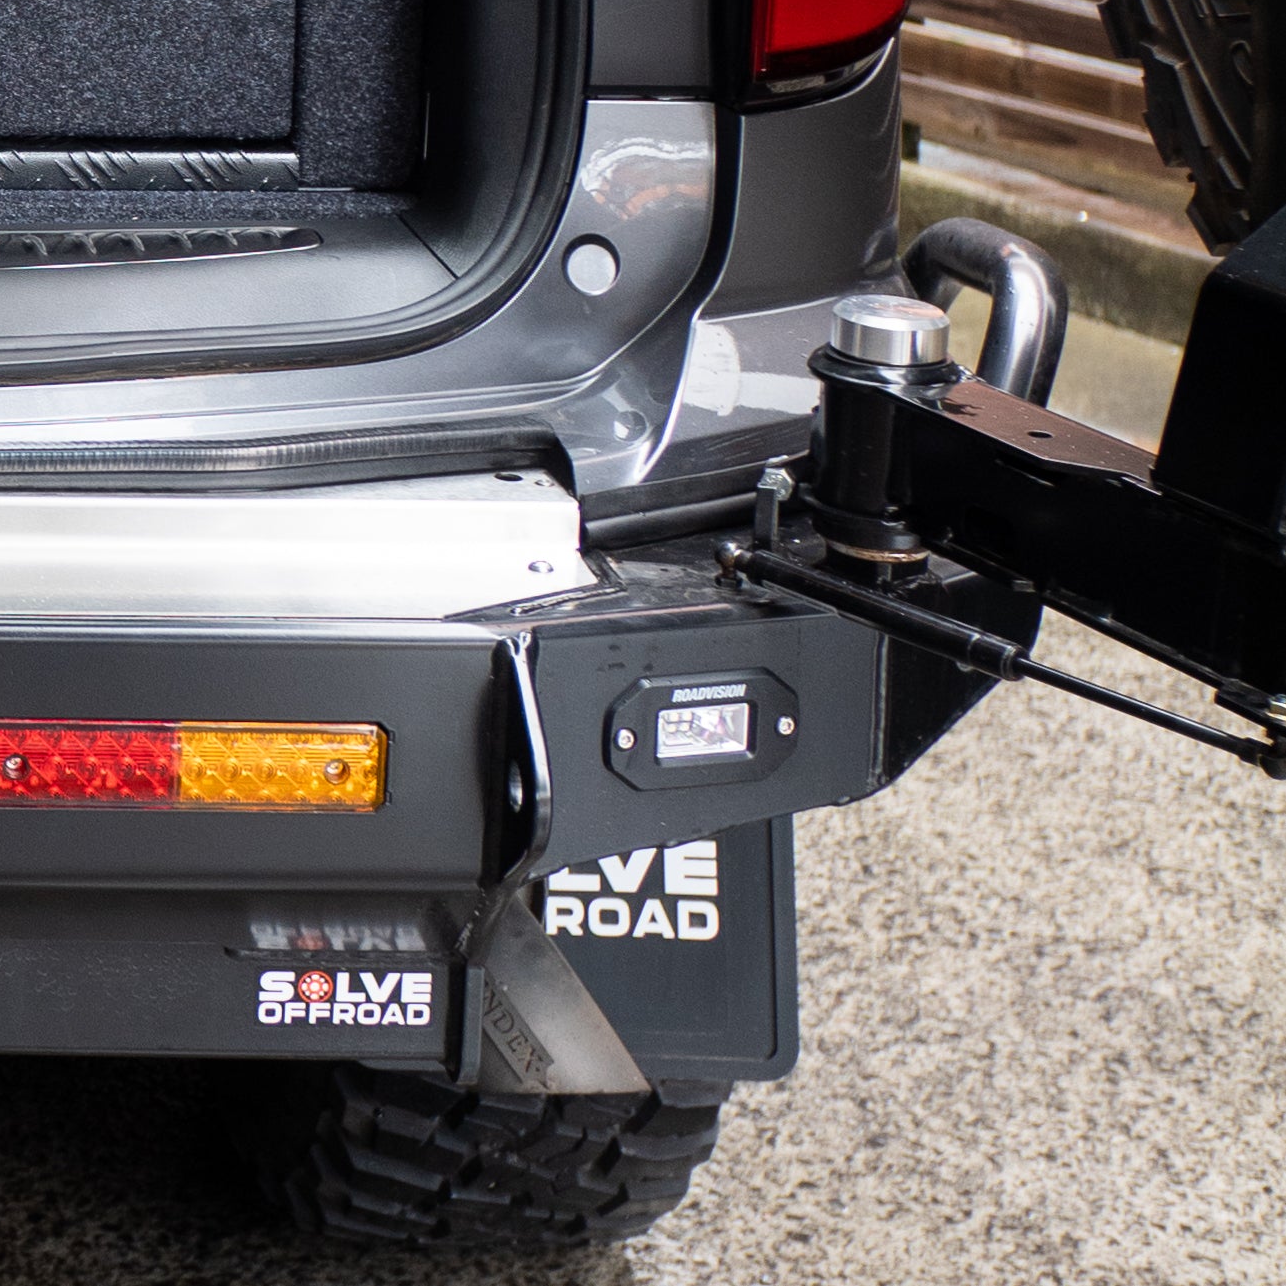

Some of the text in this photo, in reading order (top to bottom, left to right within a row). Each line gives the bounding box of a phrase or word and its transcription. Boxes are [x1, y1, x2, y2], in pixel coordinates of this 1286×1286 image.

[672, 684, 747, 703] ROADVISION
[258, 970, 433, 1003] SOLVE
[257, 1002, 431, 1026] OFFROAD
